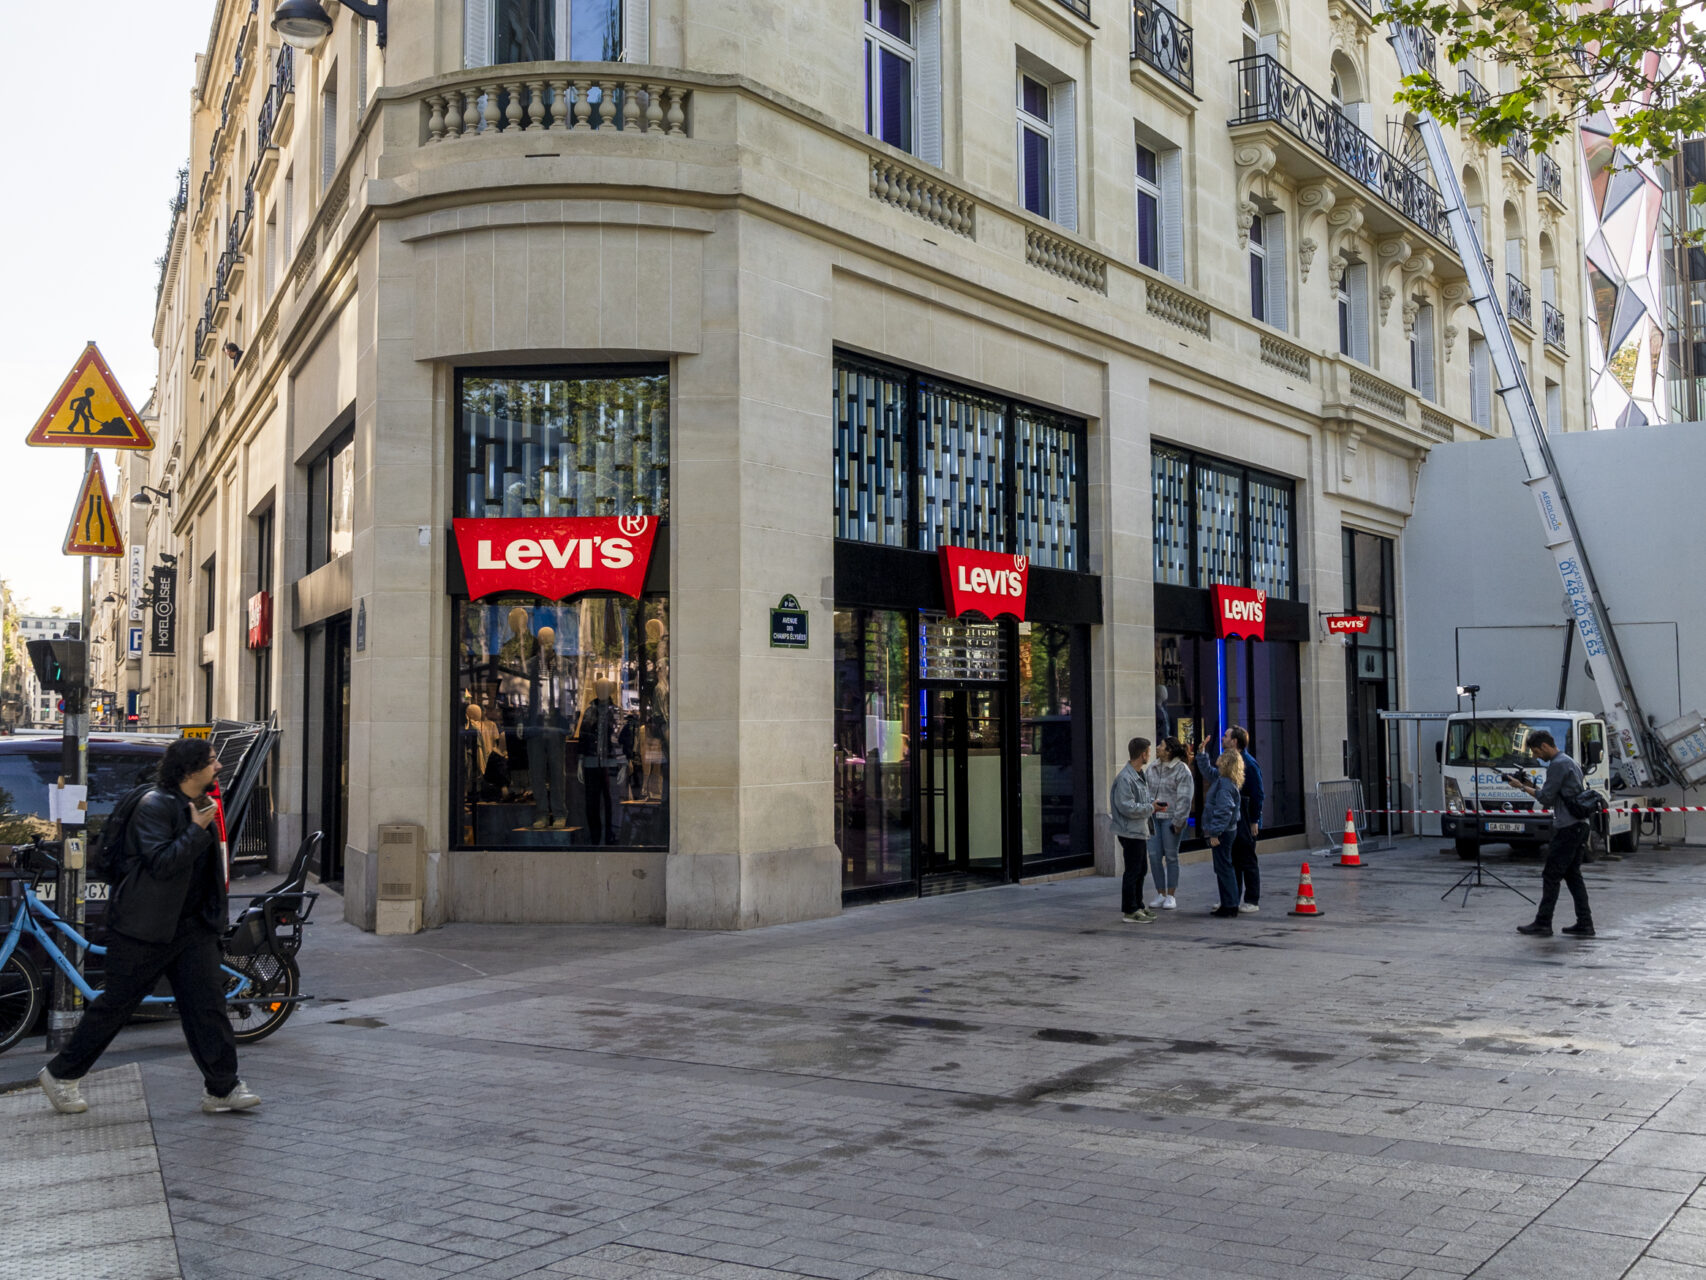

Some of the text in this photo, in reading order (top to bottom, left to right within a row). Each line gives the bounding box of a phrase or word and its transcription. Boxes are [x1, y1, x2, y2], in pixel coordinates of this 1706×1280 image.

[1559, 561, 1600, 657] 01 48 40 63 63
